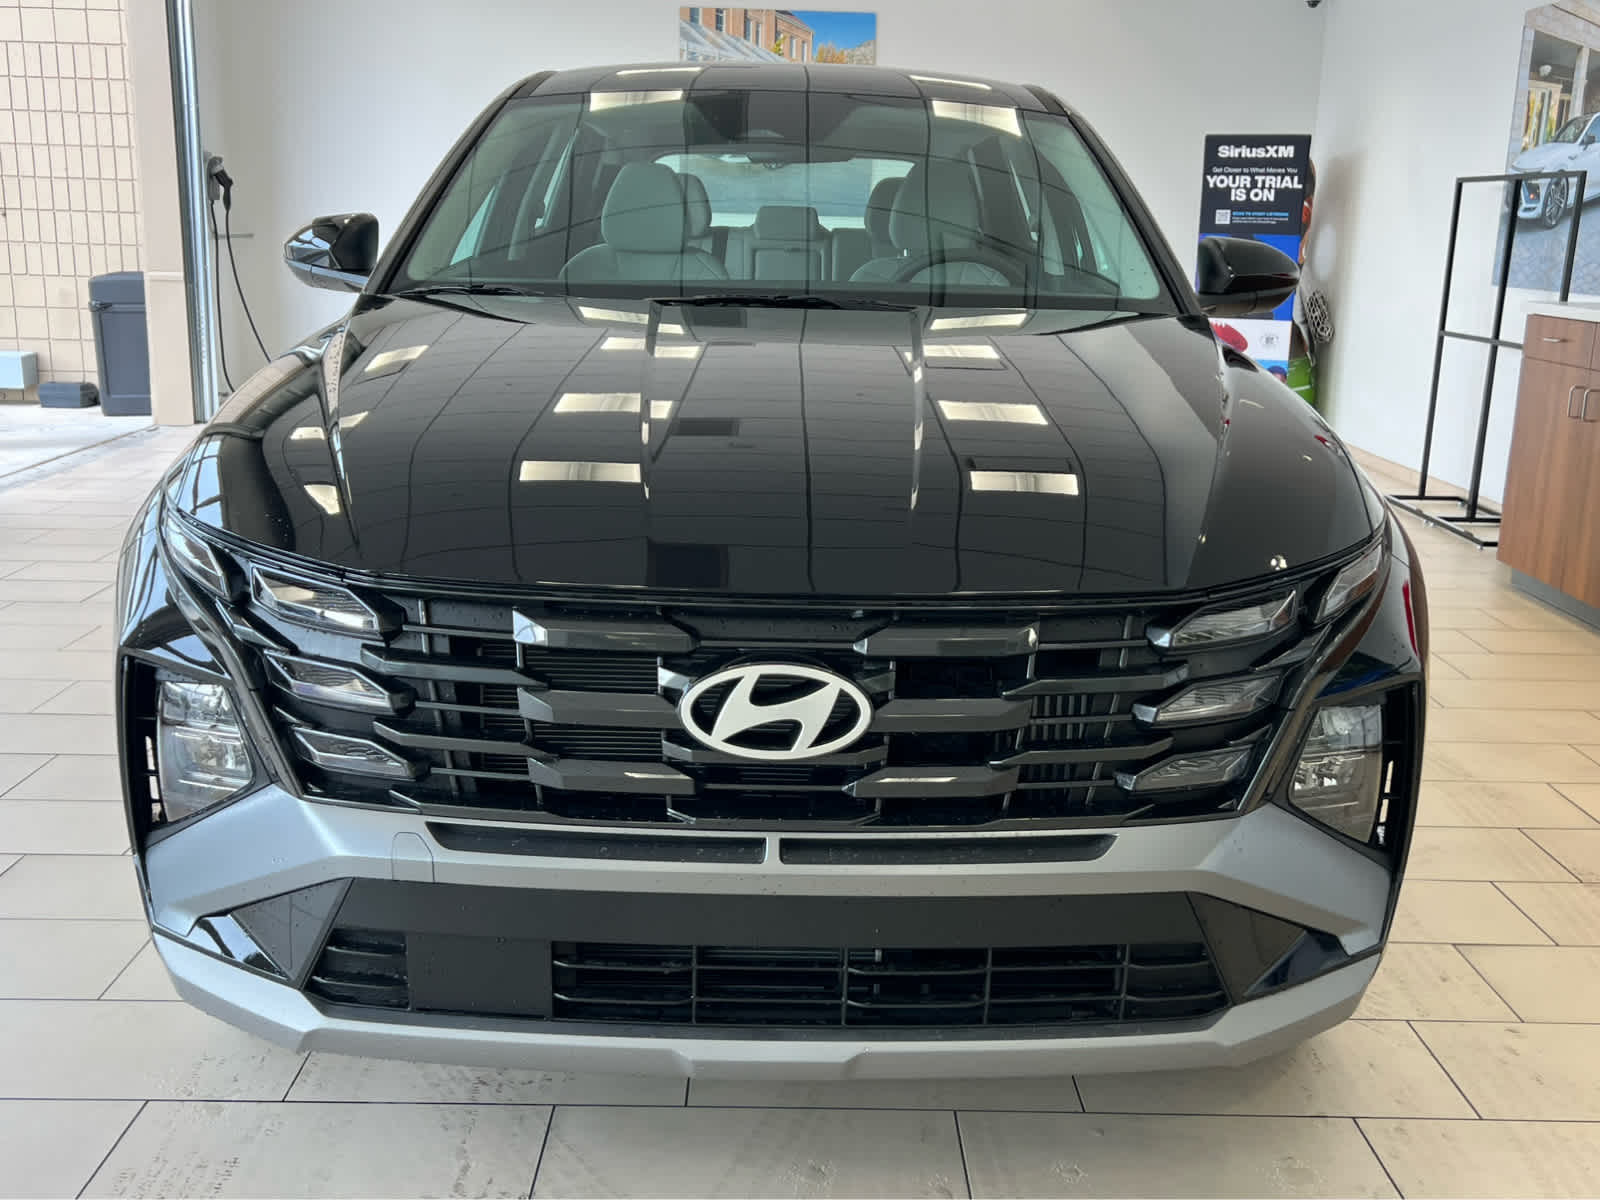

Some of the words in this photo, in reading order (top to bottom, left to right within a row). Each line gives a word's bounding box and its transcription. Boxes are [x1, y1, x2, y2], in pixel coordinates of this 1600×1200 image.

[1217, 145, 1294, 158] SiriusXM
[1206, 175, 1251, 188] YOUR
[1254, 175, 1303, 189] TRIAL
[1231, 188, 1247, 201] IS
[1249, 188, 1275, 202] ON
